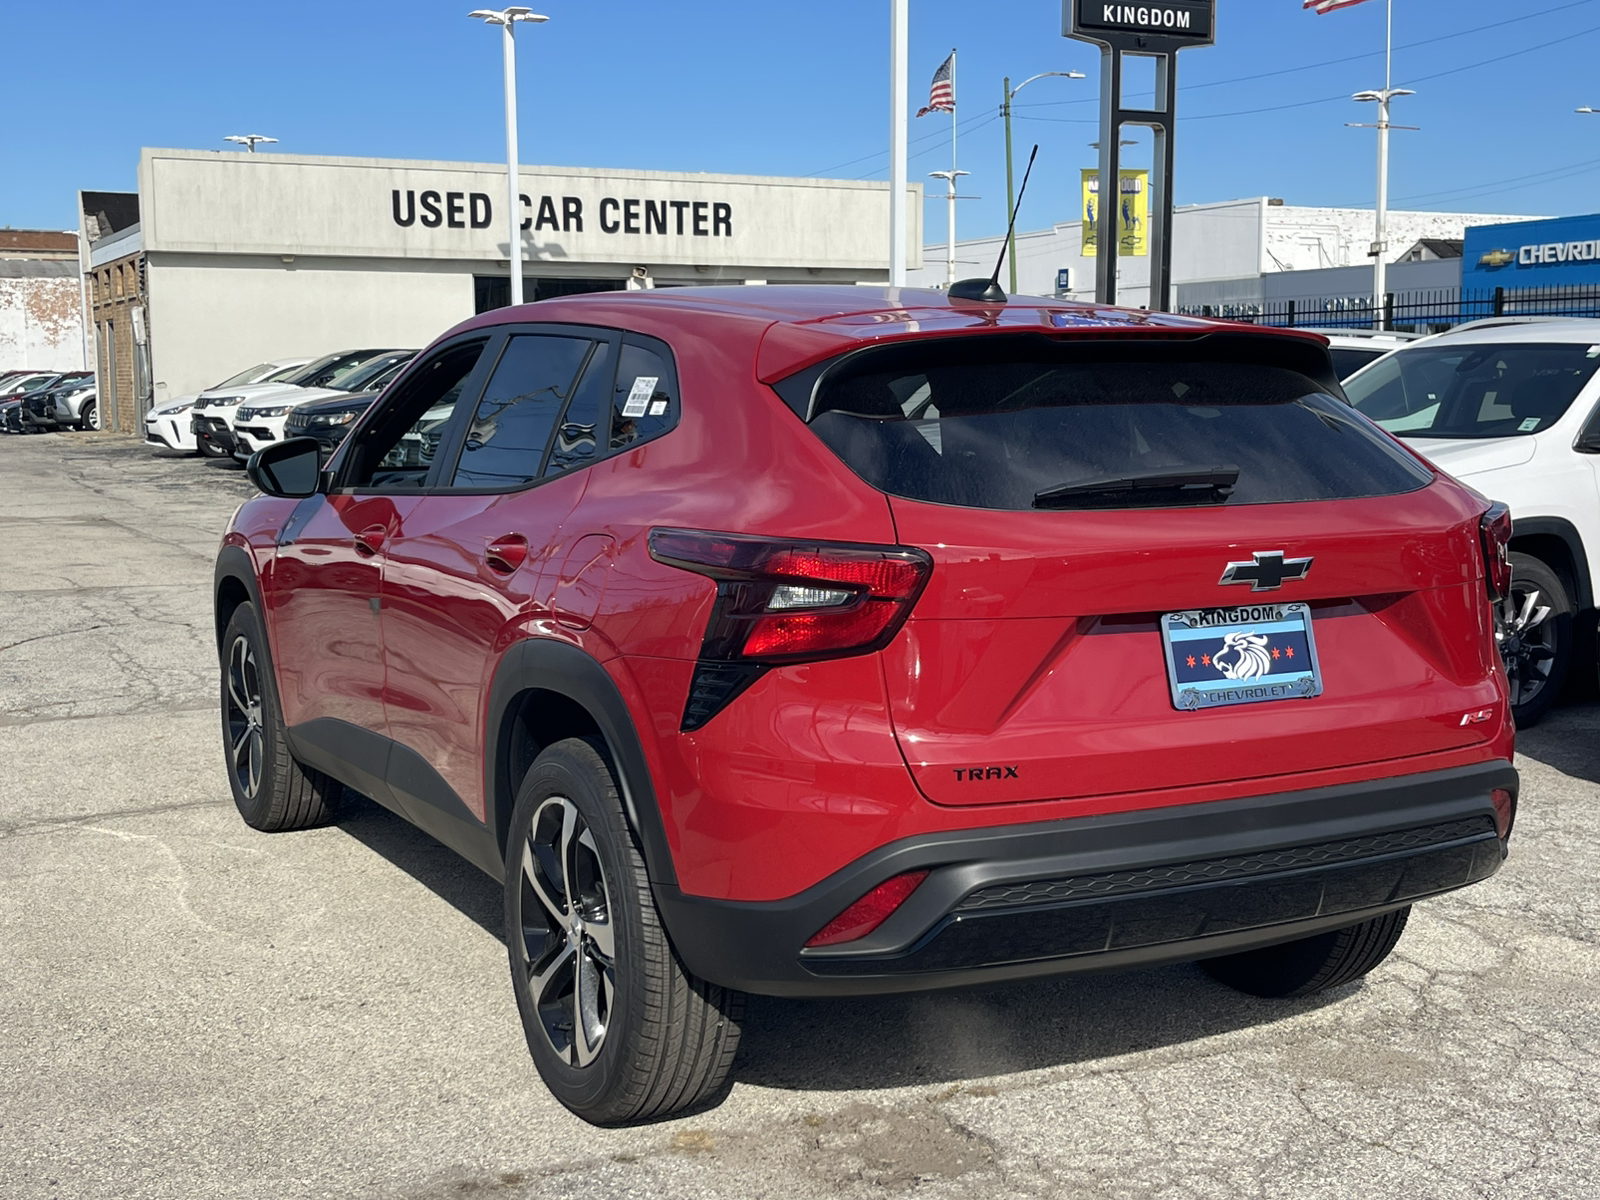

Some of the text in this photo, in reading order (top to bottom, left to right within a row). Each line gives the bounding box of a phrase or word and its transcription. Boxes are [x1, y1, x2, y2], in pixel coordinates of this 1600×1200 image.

[1103, 4, 1190, 29] KINGDOM
[391, 189, 732, 237] USED CAR CENTER
[1200, 606, 1274, 626] KINGDOM
[1209, 685, 1288, 703] CHEVROLET
[953, 765, 1018, 781] TRAX
